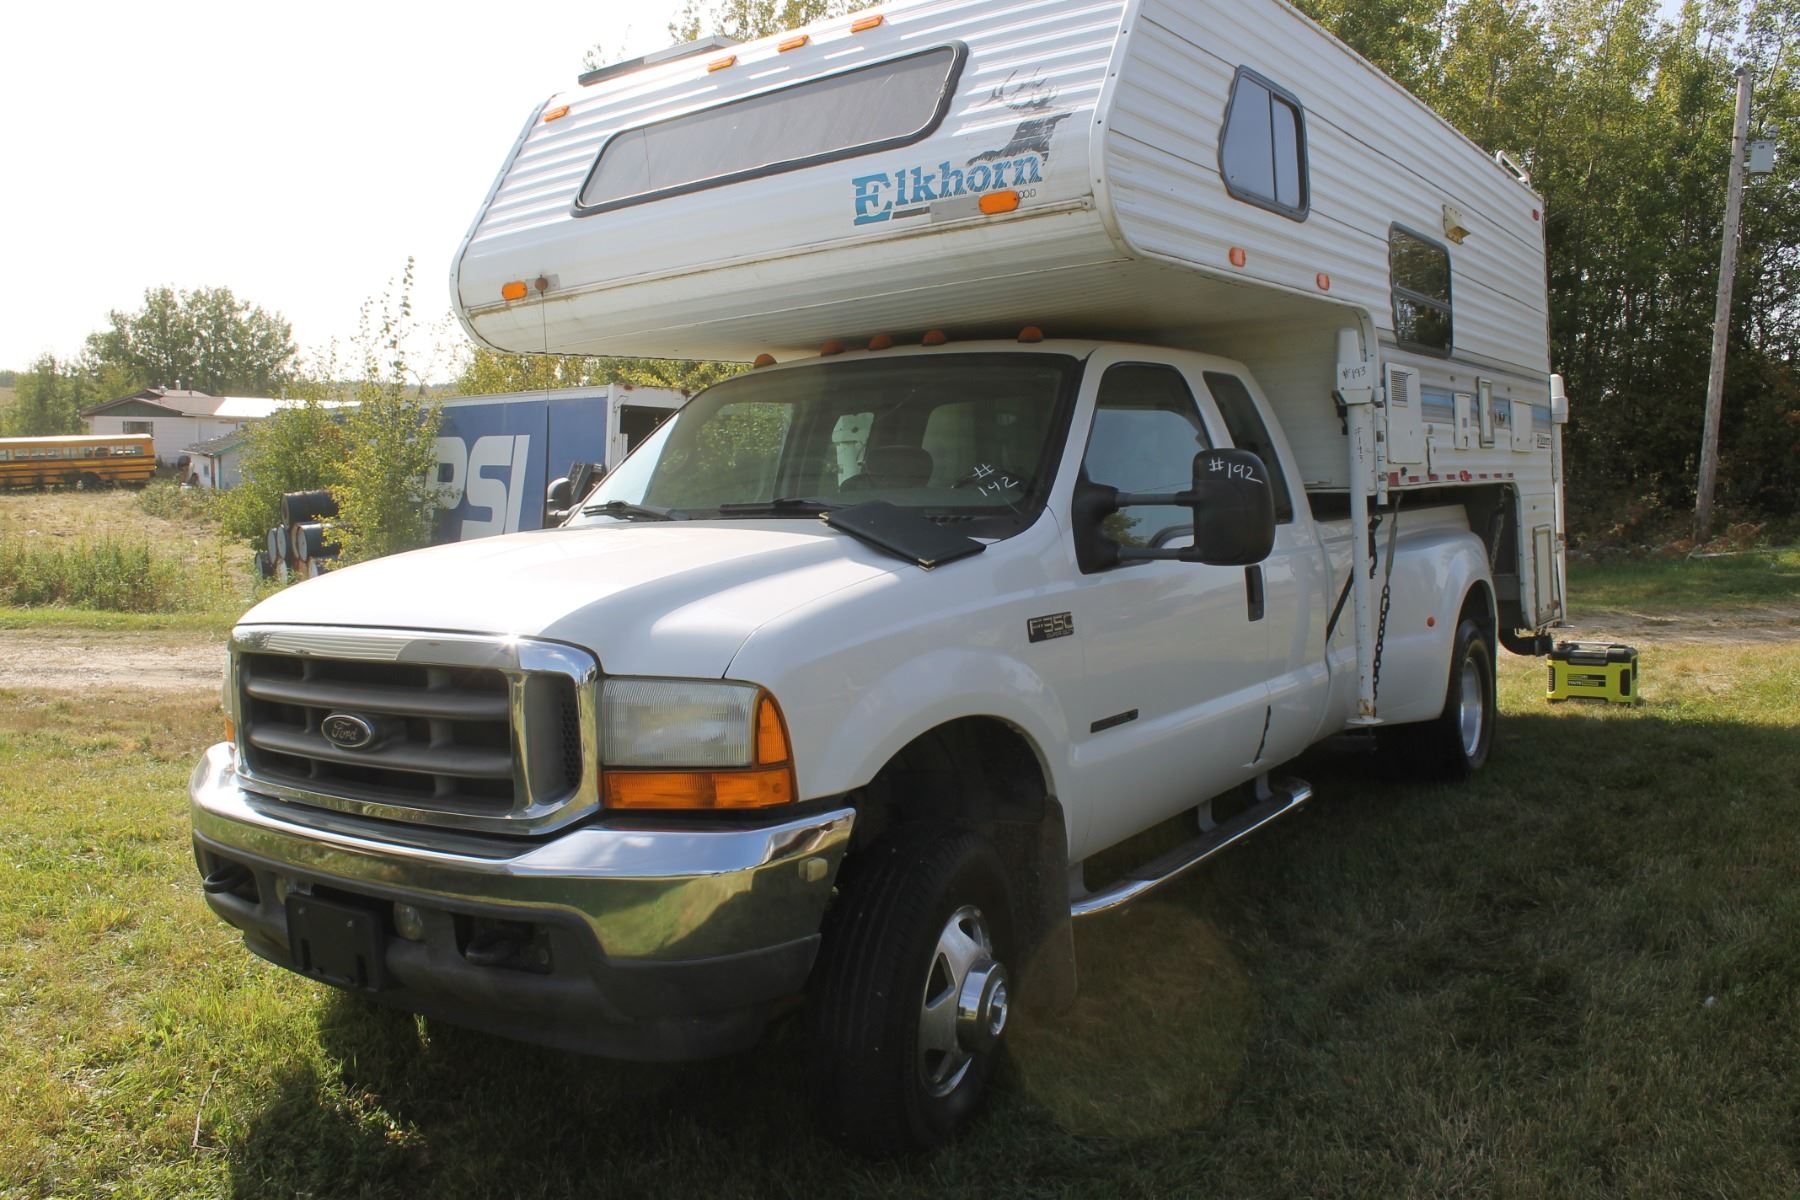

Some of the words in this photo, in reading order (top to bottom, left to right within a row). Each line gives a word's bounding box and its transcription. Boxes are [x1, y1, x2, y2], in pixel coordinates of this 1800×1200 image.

[852, 155, 1042, 226] Elkhorn
[1208, 456, 1264, 484] #192
[332, 720, 358, 741] Ford
